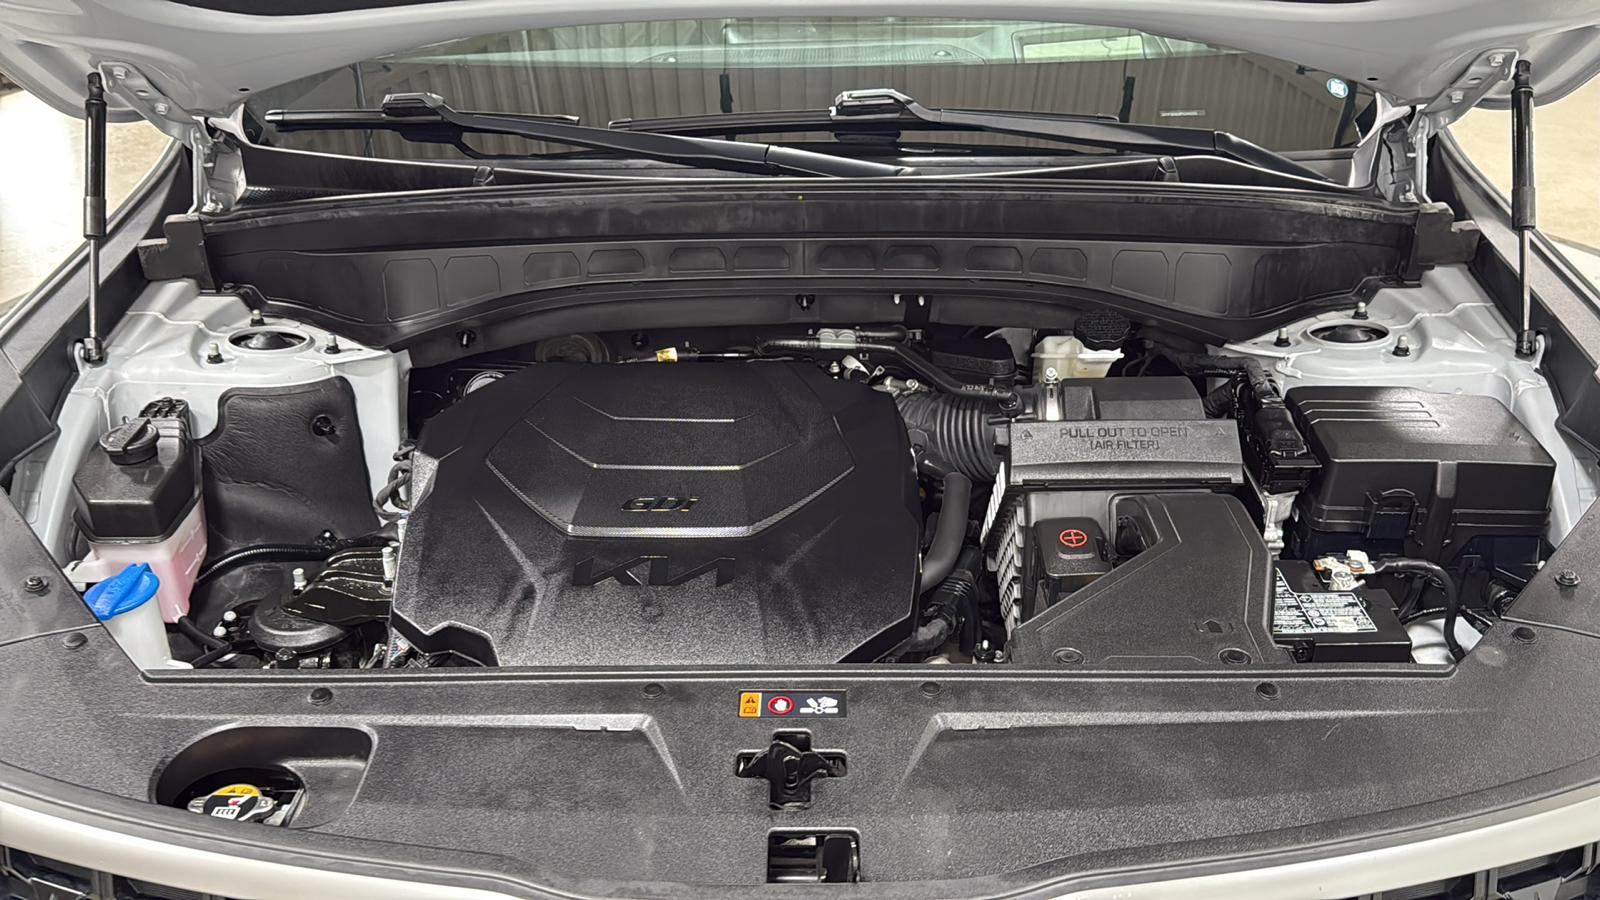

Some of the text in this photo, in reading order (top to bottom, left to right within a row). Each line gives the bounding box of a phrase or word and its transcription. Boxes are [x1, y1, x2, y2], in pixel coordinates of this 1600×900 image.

[1060, 427, 1188, 439] PULL OUT TO OPEN
[572, 555, 736, 587] KIA
